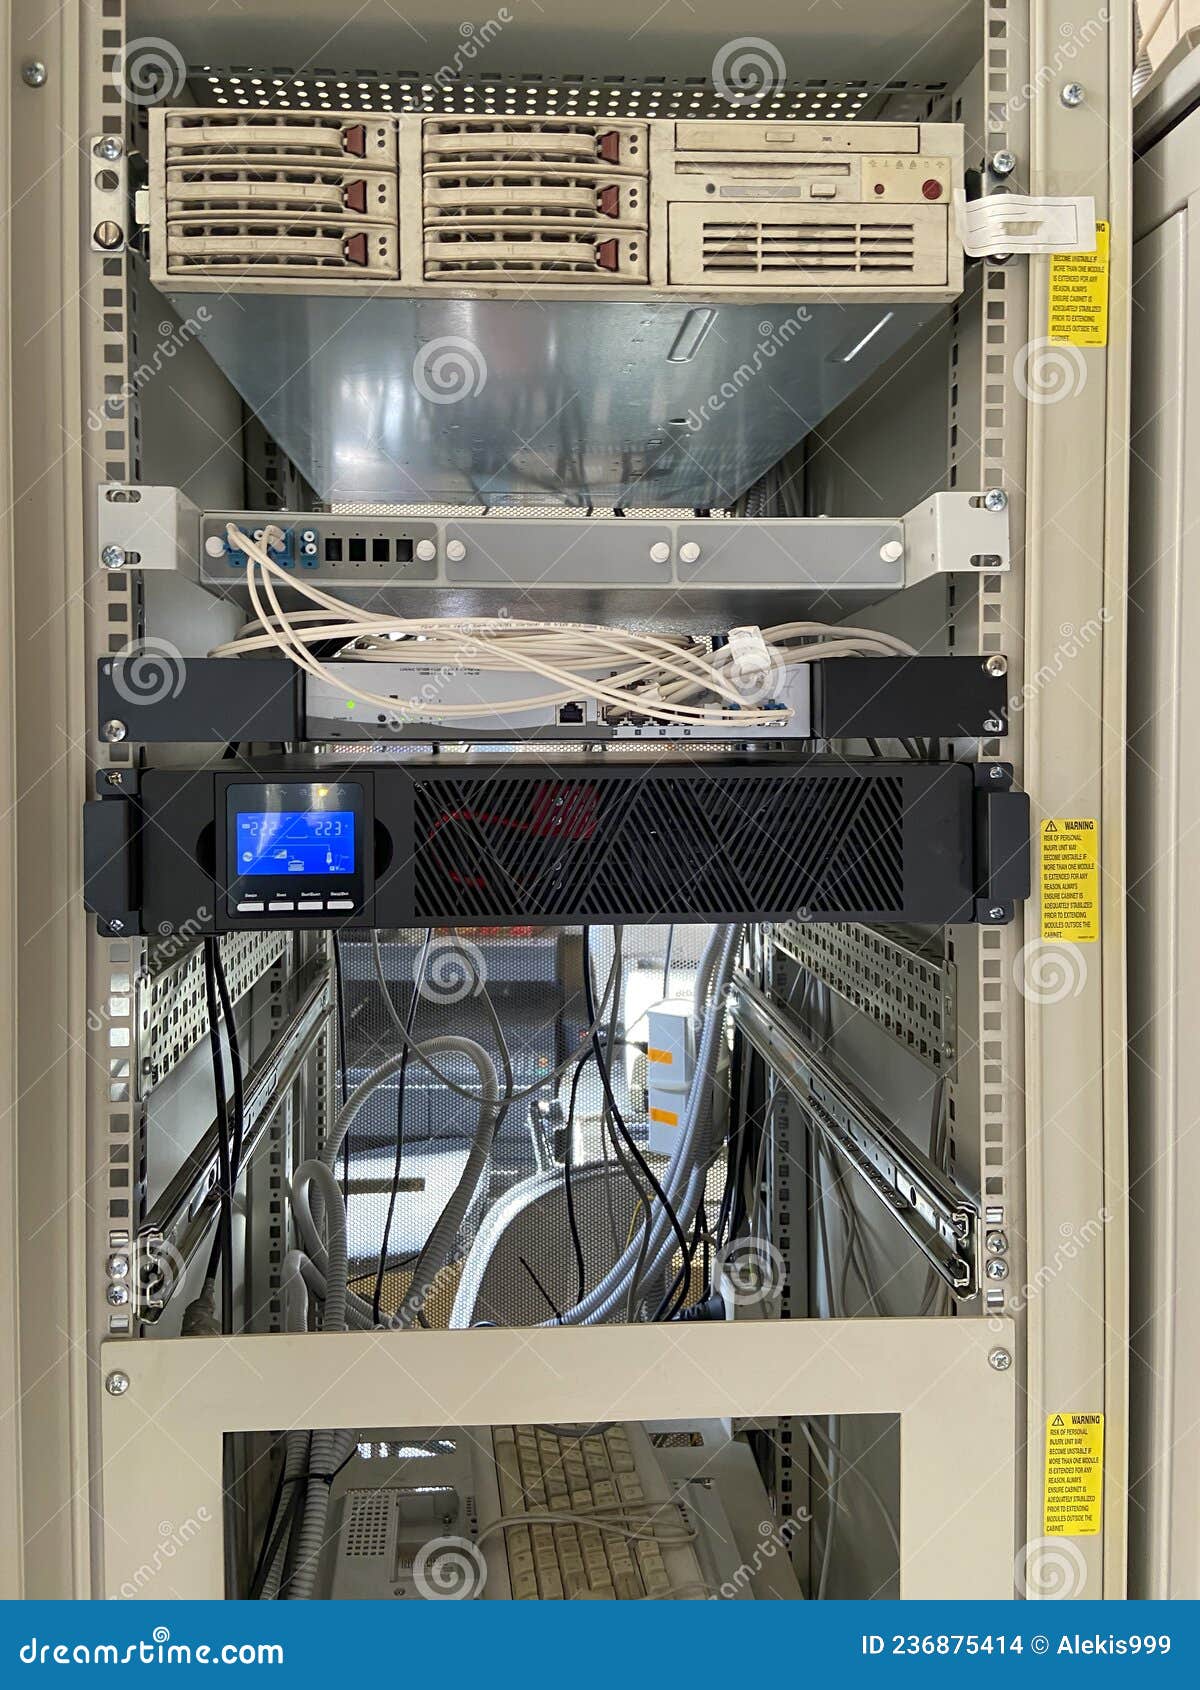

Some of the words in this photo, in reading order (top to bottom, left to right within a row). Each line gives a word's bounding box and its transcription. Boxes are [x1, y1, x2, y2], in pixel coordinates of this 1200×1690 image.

[315, 820, 342, 836] 223
[1064, 821, 1094, 830] WARNING
[1072, 1416, 1100, 1424] WARNING
